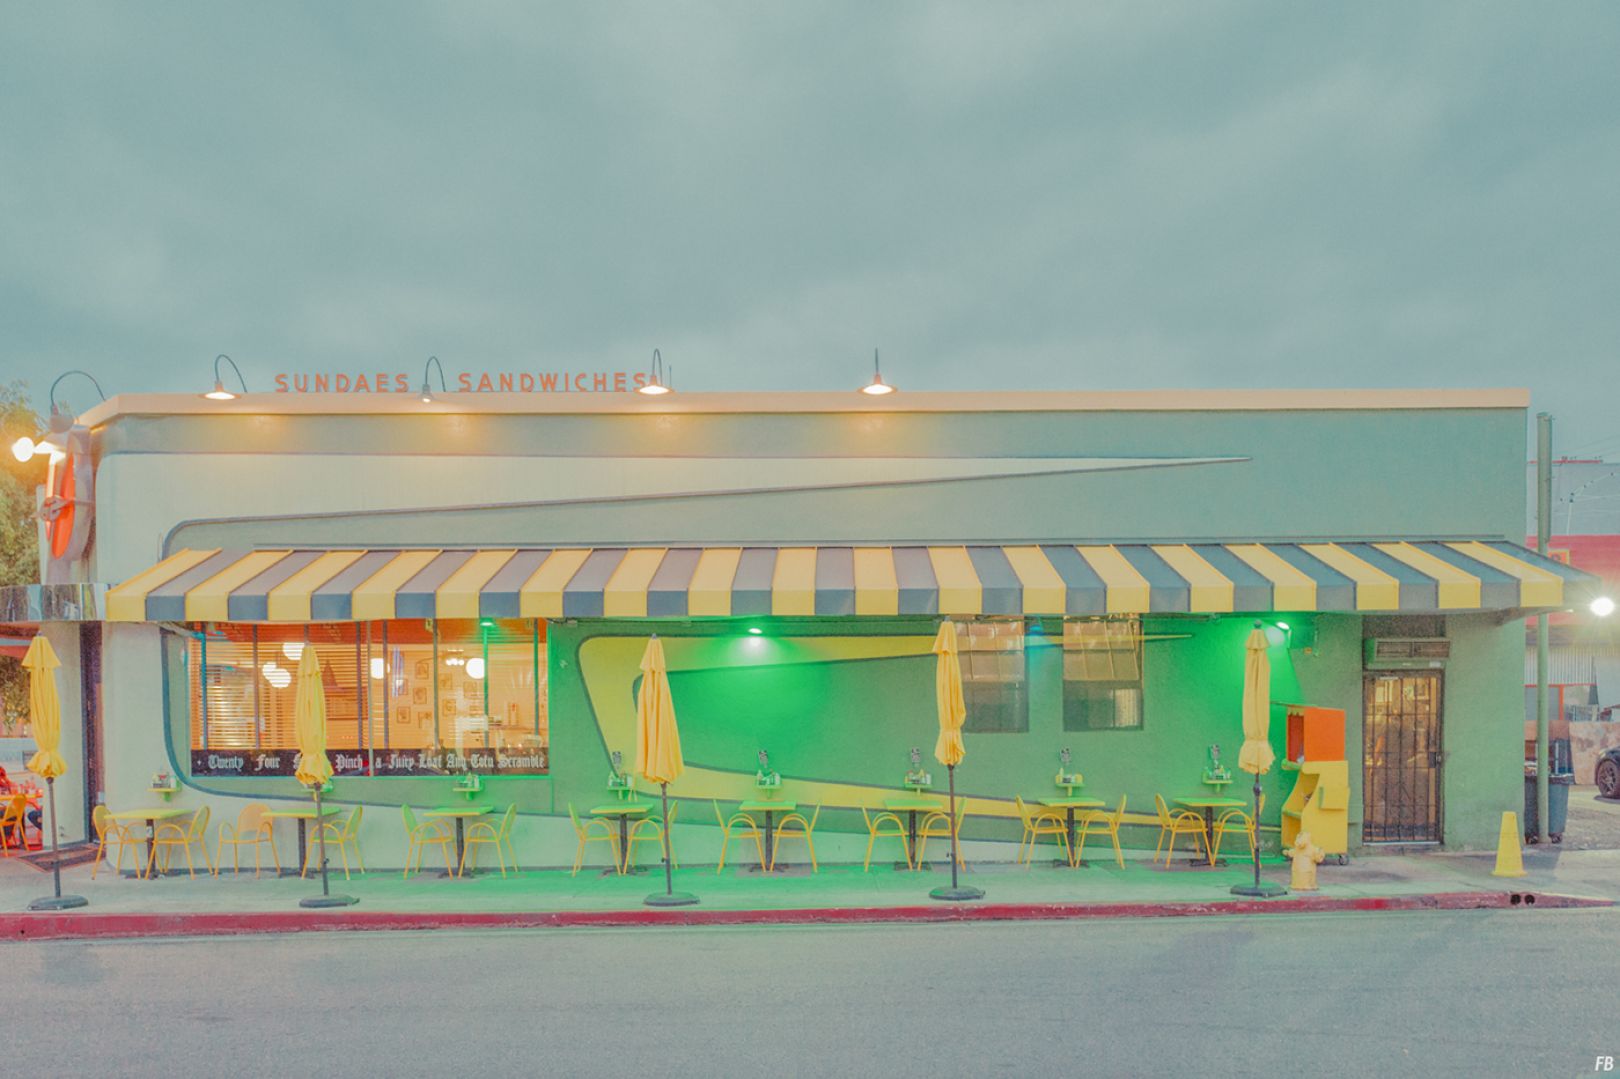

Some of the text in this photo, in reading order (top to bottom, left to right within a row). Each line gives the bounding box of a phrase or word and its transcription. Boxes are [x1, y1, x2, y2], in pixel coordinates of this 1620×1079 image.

[275, 373, 646, 393] SUNDAES SANDWICHES
[208, 754, 244, 772] Twenty
[254, 754, 281, 772] Four
[335, 754, 363, 772] Pinch
[375, 756, 382, 769] a
[389, 753, 415, 771] Juicy
[471, 753, 494, 768] Tofu
[498, 752, 545, 769] Scramble
